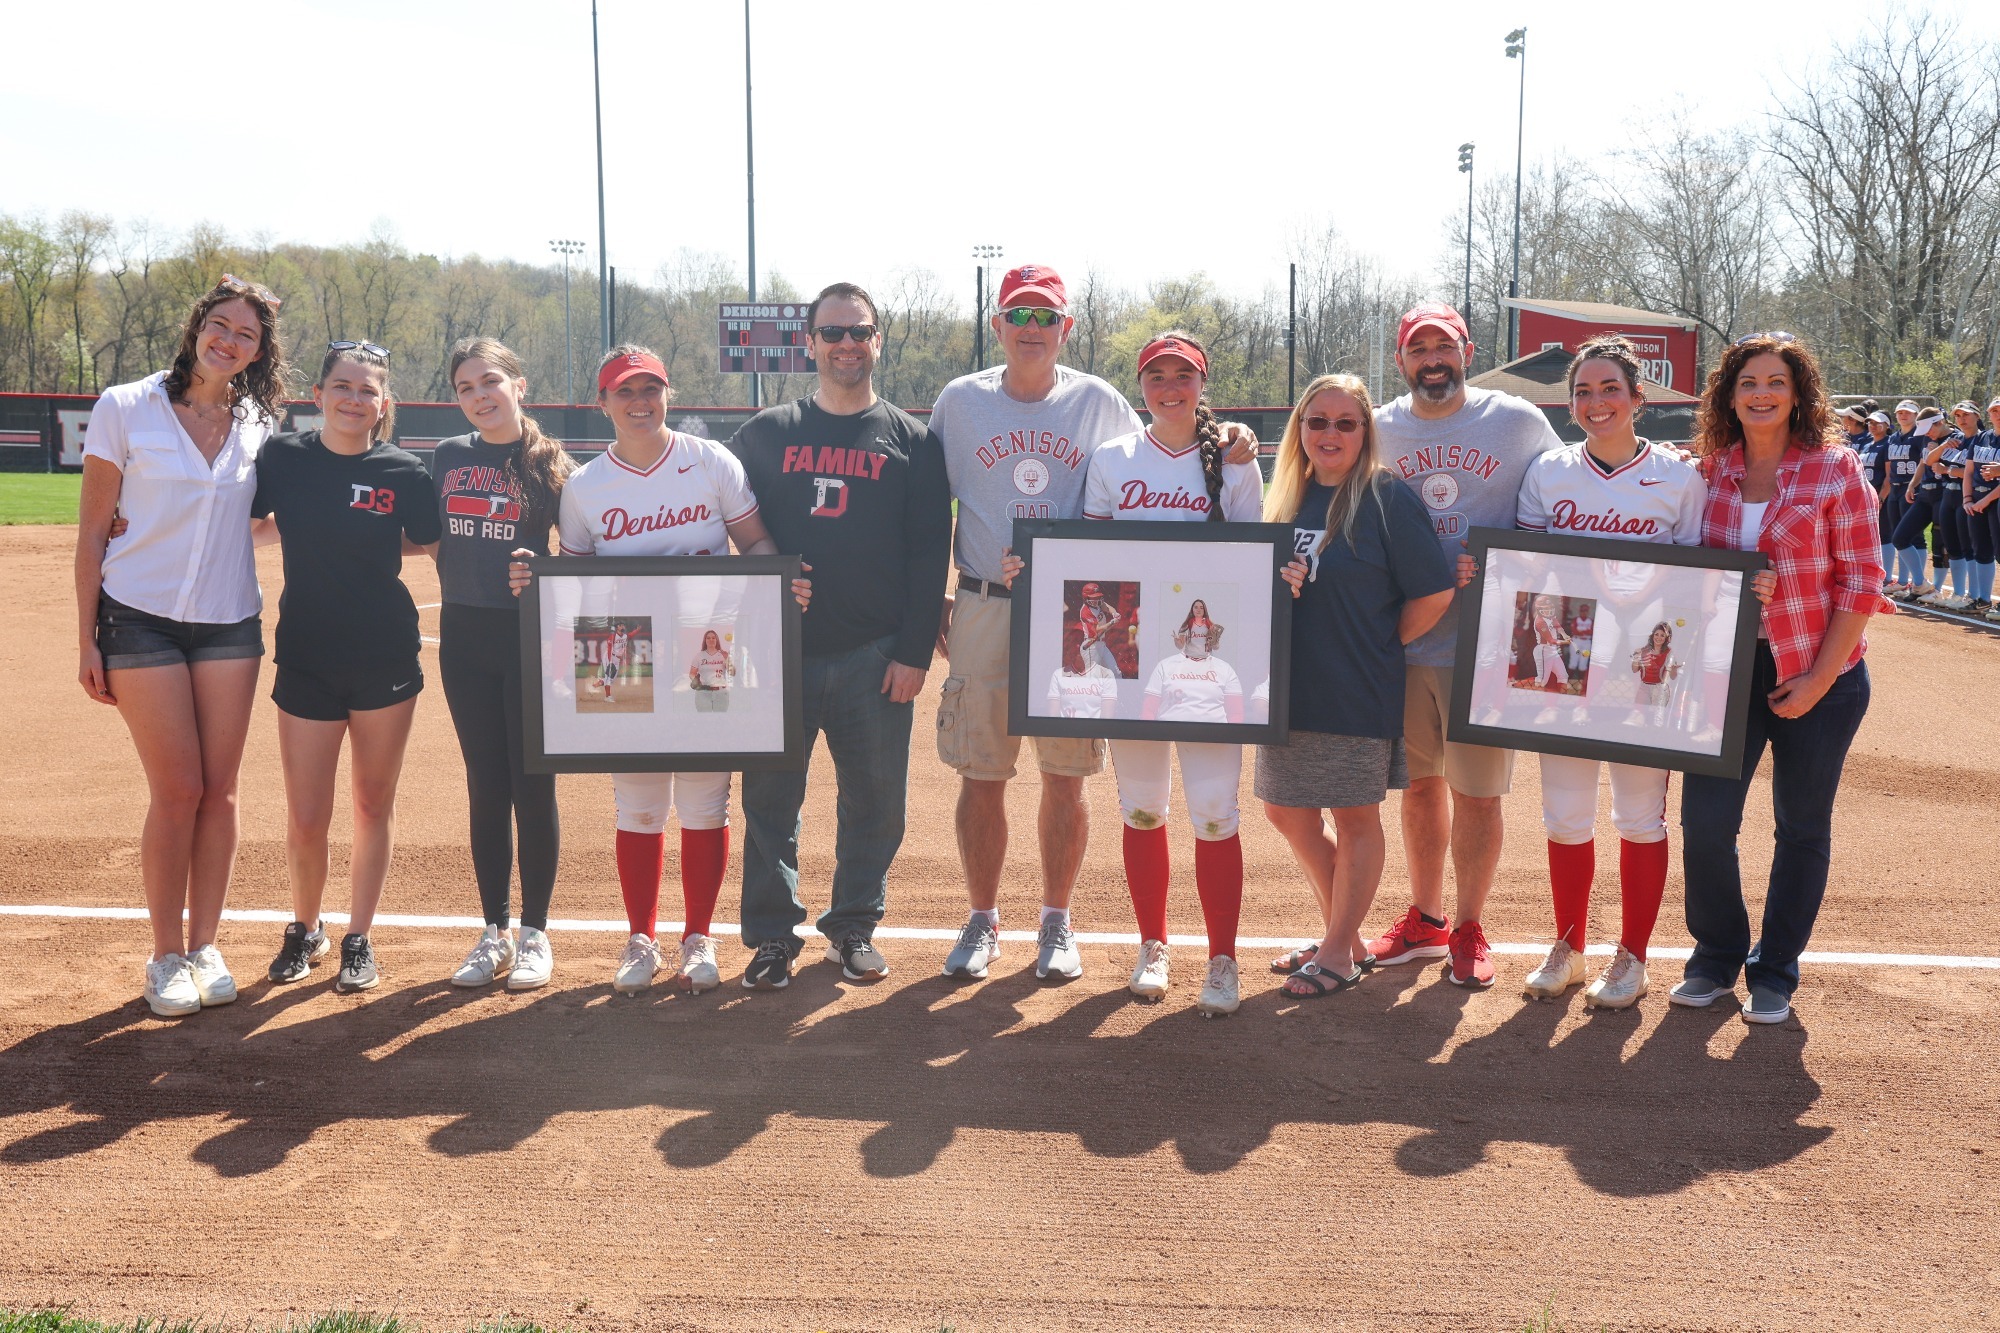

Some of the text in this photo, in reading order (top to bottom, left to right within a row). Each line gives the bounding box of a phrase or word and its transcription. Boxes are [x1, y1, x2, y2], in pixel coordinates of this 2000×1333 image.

[722, 305, 779, 318] DENISON
[776, 321, 802, 331] INNING
[740, 330, 750, 346] 0
[729, 348, 746, 357] BALL
[761, 348, 786, 357] STRIKE
[1635, 343, 1660, 353] NISON
[975, 430, 1086, 471] DENISON
[782, 446, 889, 481] FAMILY
[1395, 445, 1501, 482] ENISON
[1896, 461, 1917, 475] 29
[349, 483, 395, 513] D3
[1015, 503, 1049, 519] DAD
[1552, 499, 1659, 535] Denison
[448, 518, 516, 541] BIG RED
[601, 504, 711, 541] Denison
[1435, 516, 1459, 535] AD
[1294, 532, 1316, 554] 12
